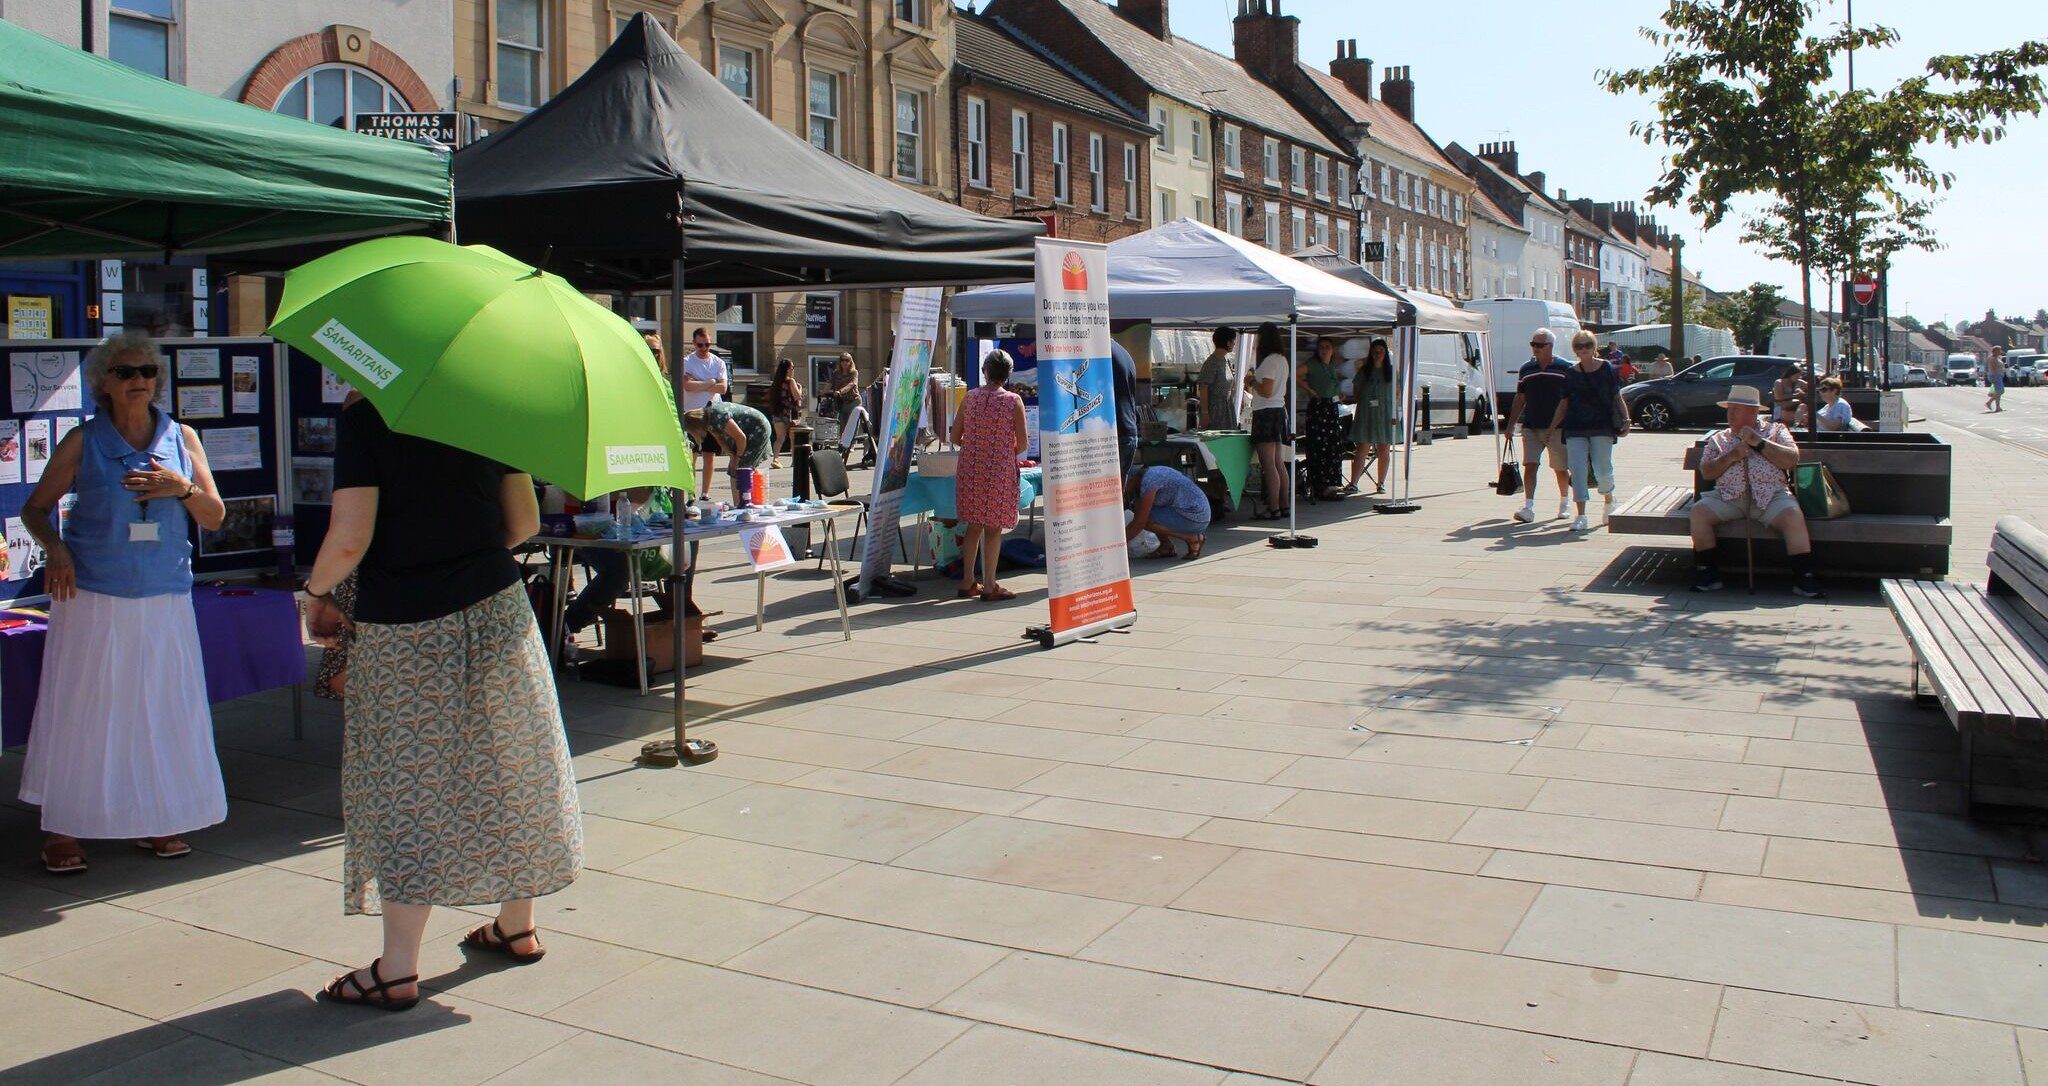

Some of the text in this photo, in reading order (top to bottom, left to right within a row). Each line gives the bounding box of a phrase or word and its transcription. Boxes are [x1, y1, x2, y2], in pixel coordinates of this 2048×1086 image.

[371, 116, 441, 127] THOMAS
[1369, 245, 1381, 256] W
[1043, 299, 1052, 309] Do
[1069, 302, 1087, 312] anyone
[1087, 302, 1096, 313] you
[1070, 314, 1081, 325] free
[1045, 331, 1052, 339] or
[322, 327, 392, 380] SAMARITANS
[609, 453, 665, 466] SAMARITANS
